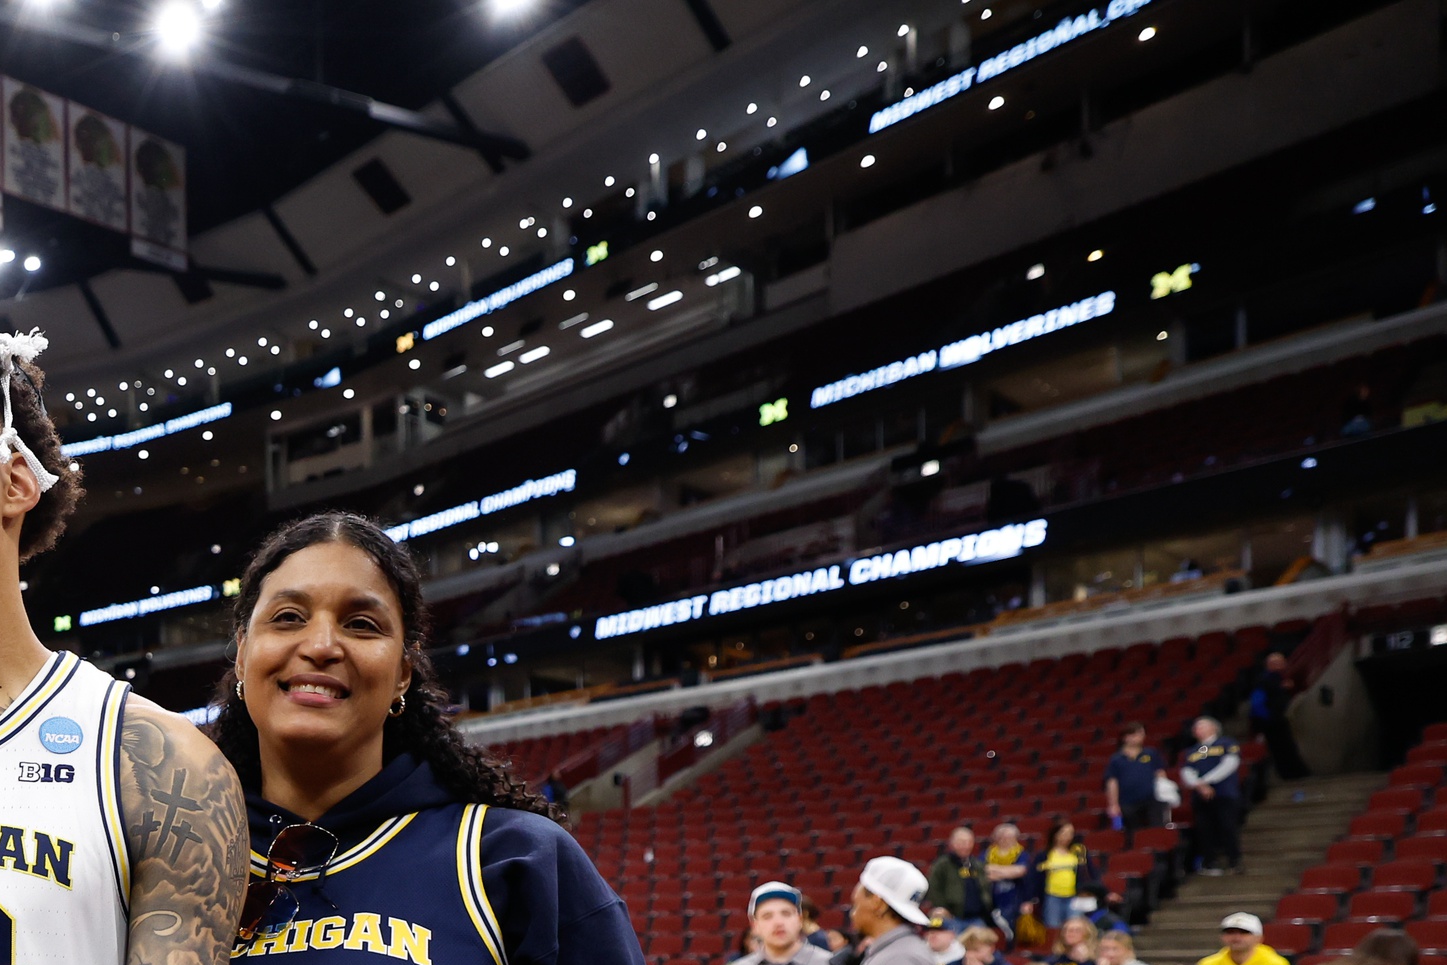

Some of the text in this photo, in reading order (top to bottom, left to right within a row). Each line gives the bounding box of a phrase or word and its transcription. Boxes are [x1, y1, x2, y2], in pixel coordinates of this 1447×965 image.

[595, 518, 1049, 640] MIDWEST REGIONAL CHAMPIONS
[44, 731, 80, 745] NCAA
